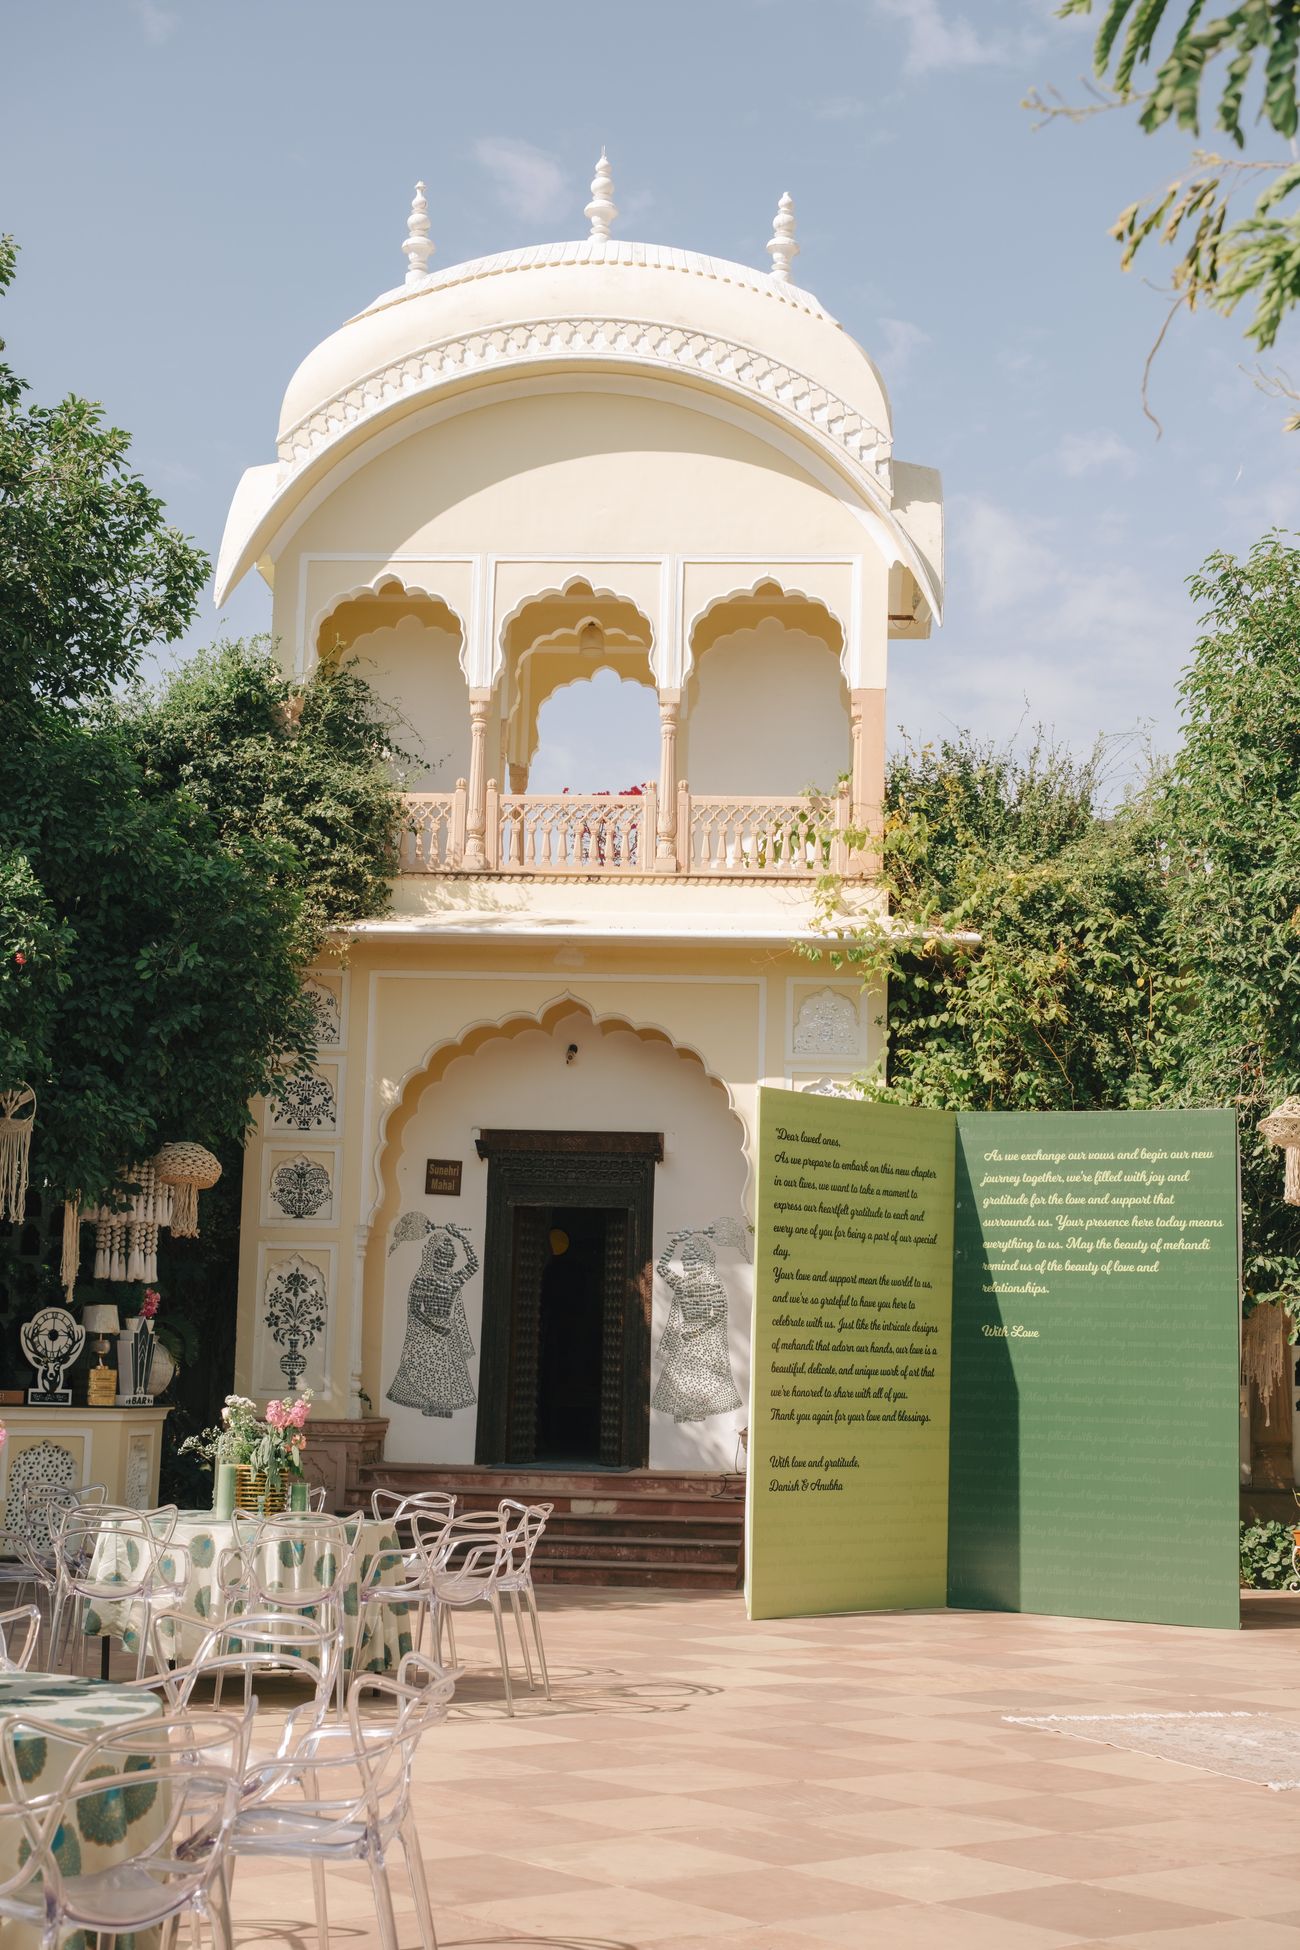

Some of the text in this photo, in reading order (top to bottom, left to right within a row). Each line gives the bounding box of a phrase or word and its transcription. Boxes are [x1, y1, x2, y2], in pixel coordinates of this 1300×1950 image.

[801, 1131, 822, 1144] loved
[984, 1149, 1003, 1161] As
[1020, 1149, 1067, 1164] exchange
[1068, 1152, 1086, 1160] our
[1088, 1152, 1115, 1160] vows
[1117, 1148, 1140, 1159] and
[1139, 1148, 1169, 1164] begin
[1170, 1151, 1190, 1159] our
[429, 1164, 459, 1176] Sunehri
[775, 1152, 789, 1164] As
[801, 1158, 832, 1170] prepare
[833, 1160, 840, 1168] to
[842, 1160, 868, 1172] embark
[881, 1164, 894, 1174] this
[911, 1166, 936, 1180] chapter
[431, 1178, 455, 1190] Mahal
[980, 1172, 1021, 1187] journey
[1093, 1170, 1123, 1185] filled
[1123, 1171, 1147, 1183] with
[1145, 1173, 1166, 1186] joy
[1167, 1170, 1190, 1182] and
[774, 1176, 782, 1186] in
[831, 1184, 849, 1192] want
[851, 1184, 858, 1193] to
[860, 1184, 874, 1195] take
[882, 1190, 909, 1198] moment
[911, 1190, 918, 1198] to
[983, 1192, 1175, 1208] gratitude for the love and support that
[774, 1202, 802, 1213] express
[818, 1202, 849, 1218] heartfelt
[850, 1207, 882, 1219] gratitude
[884, 1210, 891, 1218] to
[893, 1210, 908, 1220] each
[910, 1211, 925, 1221] and
[983, 1214, 1224, 1232] surrounds us. Your presence here today means
[774, 1225, 793, 1237] every
[810, 1224, 818, 1238] of
[819, 1230, 832, 1240] you
[834, 1226, 846, 1240] for
[847, 1227, 866, 1243] being
[872, 1232, 889, 1243] part
[891, 1231, 898, 1244] of
[913, 1234, 937, 1246] special
[773, 1244, 790, 1260] day.
[983, 1235, 1211, 1254] everything to May the beauty of mehandi
[982, 1259, 1160, 1278] remind of the beauty of love and
[773, 1267, 794, 1283] Your
[796, 1269, 811, 1281] love
[812, 1271, 828, 1282] and
[829, 1275, 856, 1286] support
[879, 1275, 889, 1286] the
[891, 1276, 913, 1287] world
[982, 1281, 1050, 1297] relationships.
[772, 1292, 788, 1302] and
[820, 1295, 850, 1309] grateful
[850, 1297, 858, 1306] to
[860, 1296, 876, 1307] have
[878, 1302, 890, 1312] you
[892, 1298, 907, 1309] here
[772, 1314, 938, 1336] celebrate with Just like the intricate designs
[982, 1325, 1040, 1338] With Love
[772, 1338, 780, 1352] of
[780, 1338, 814, 1350] mehandi
[815, 1340, 830, 1351] that
[832, 1341, 854, 1352] adorn
[910, 1343, 923, 1354] love
[838, 1364, 854, 1375] and
[855, 1366, 879, 1379] unique
[880, 1366, 899, 1376] work
[900, 1366, 908, 1379] of
[908, 1368, 919, 1376] art
[921, 1366, 934, 1377] that
[132, 1396, 146, 1404] BAR
[792, 1386, 824, 1397] honored
[824, 1388, 832, 1397] to
[833, 1386, 854, 1398] share
[855, 1387, 871, 1398] with
[873, 1388, 884, 1398] all
[883, 1388, 892, 1402] of
[892, 1392, 908, 1402] you.
[771, 1408, 931, 1426] Thank you again for your love and blessings.
[770, 1456, 790, 1468] With
[792, 1456, 807, 1467] love
[808, 1456, 824, 1467] and
[769, 1479, 843, 1492] Danish & Anubha
